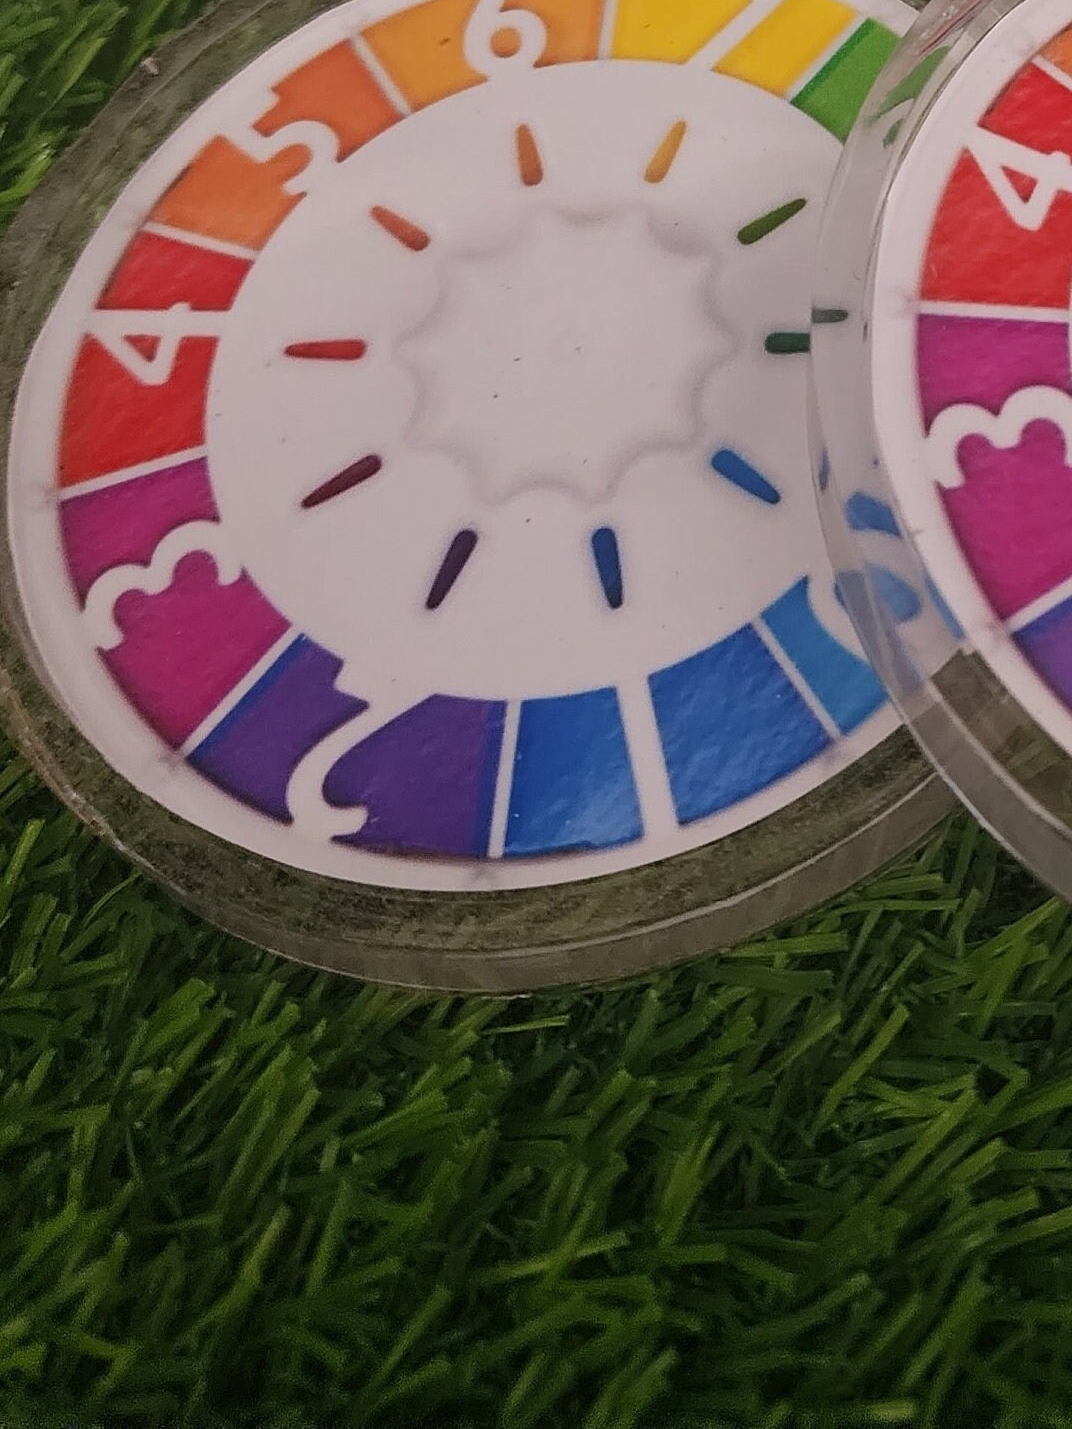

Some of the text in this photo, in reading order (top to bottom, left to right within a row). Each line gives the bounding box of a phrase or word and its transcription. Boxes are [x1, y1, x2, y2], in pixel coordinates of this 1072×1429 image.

[215, 82, 340, 193] 5
[90, 302, 224, 387] 4
[82, 518, 243, 650] 3
[285, 657, 435, 840] 2
